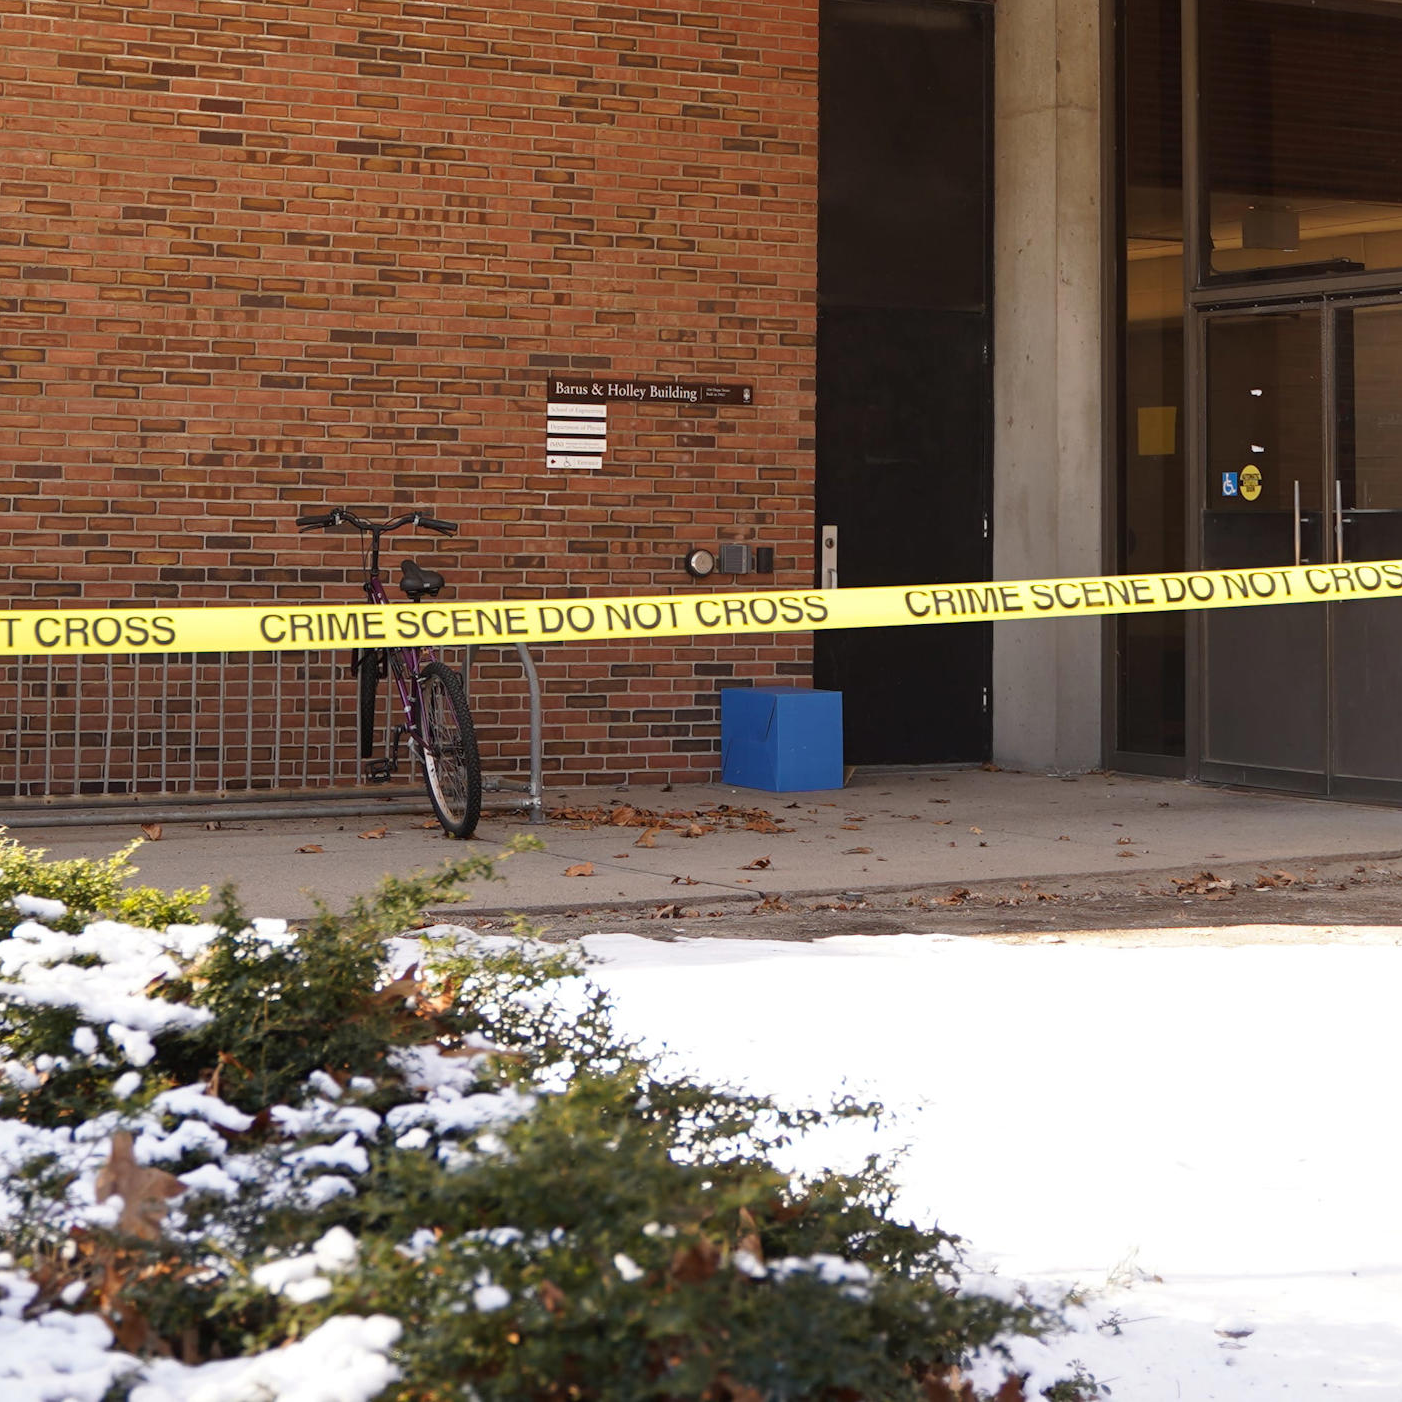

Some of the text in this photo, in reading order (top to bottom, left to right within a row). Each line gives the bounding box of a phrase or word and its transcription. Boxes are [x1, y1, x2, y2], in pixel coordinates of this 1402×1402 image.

[555, 381, 698, 403] Barus & Holley Building
[904, 587, 1023, 617] CRIME
[1030, 580, 1155, 611] SCENE
[1161, 576, 1215, 603] DO
[1222, 571, 1298, 599] NOT
[34, 616, 176, 648] CROSS
[260, 596, 828, 643] CRIME SCENE DO NOT CROSS
